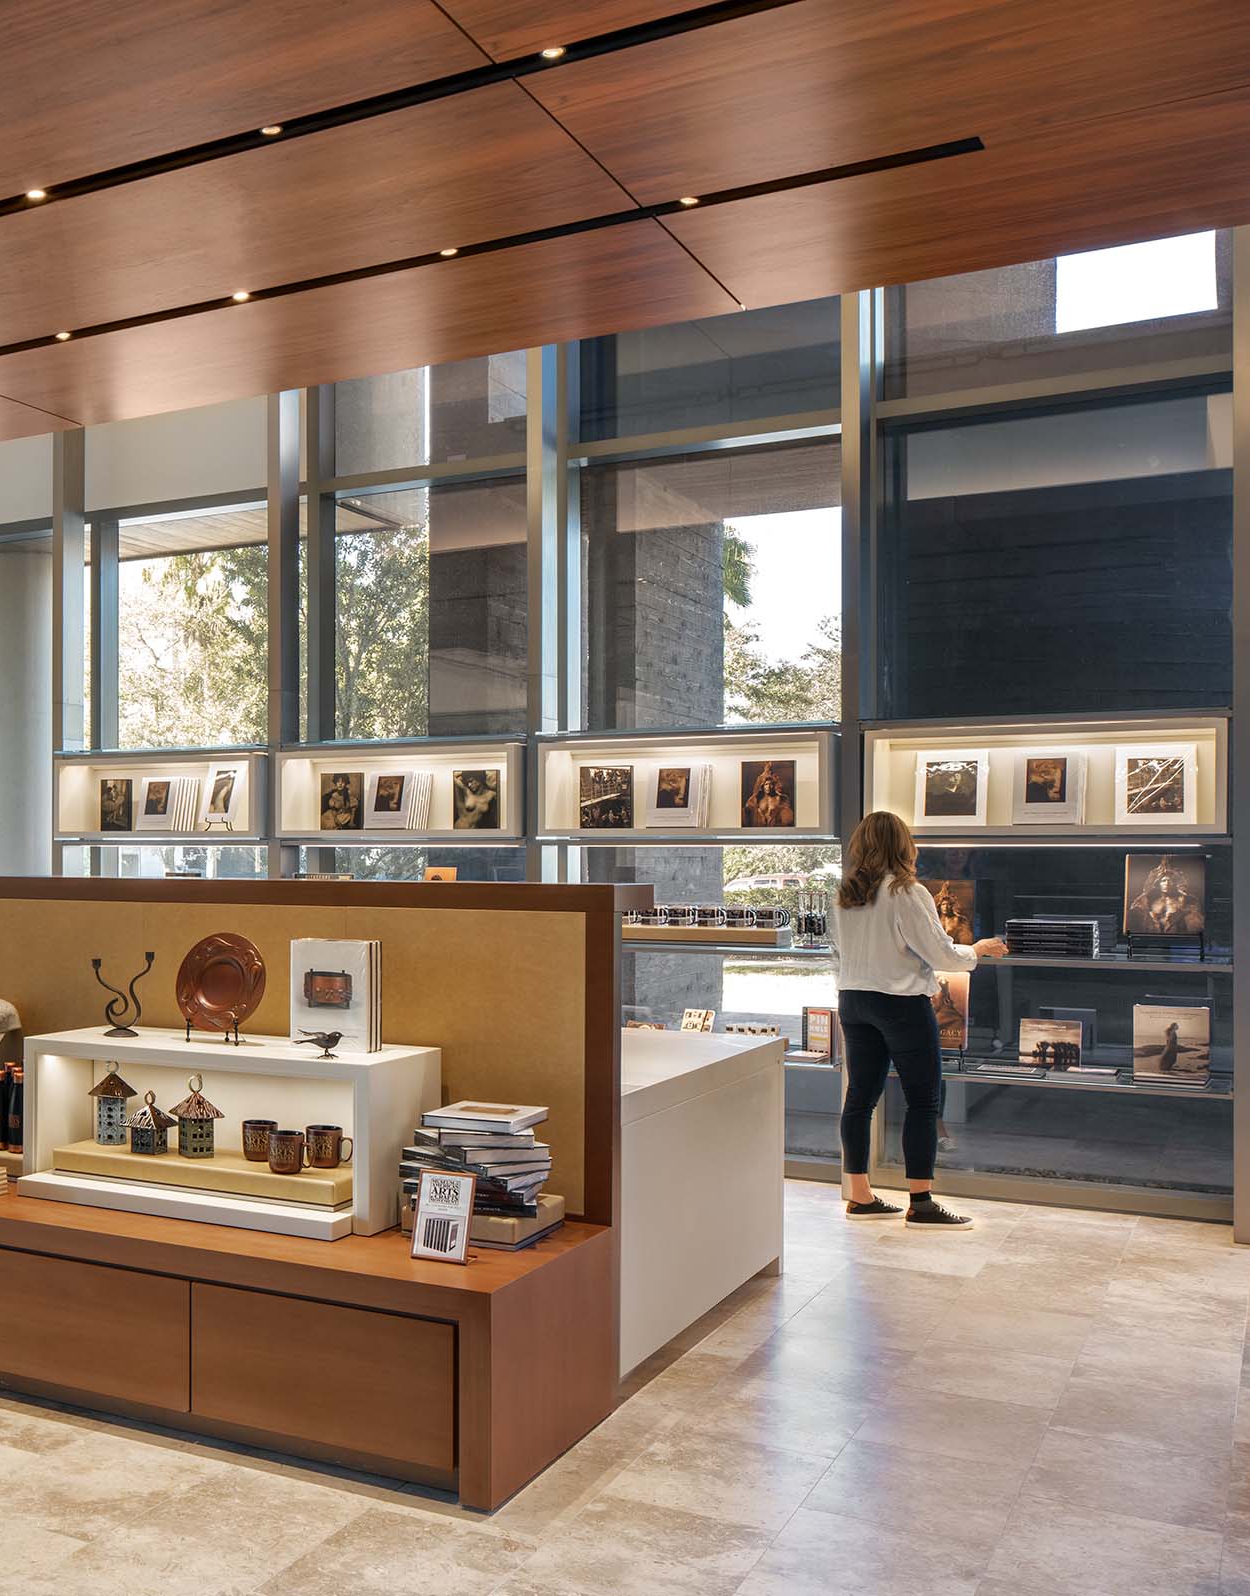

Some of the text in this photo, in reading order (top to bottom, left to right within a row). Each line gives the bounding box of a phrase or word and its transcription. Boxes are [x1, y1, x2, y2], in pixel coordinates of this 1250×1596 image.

[940, 1029, 962, 1037] GACY
[270, 1147, 295, 1156] ARTS
[432, 1186, 459, 1196] ARTS
